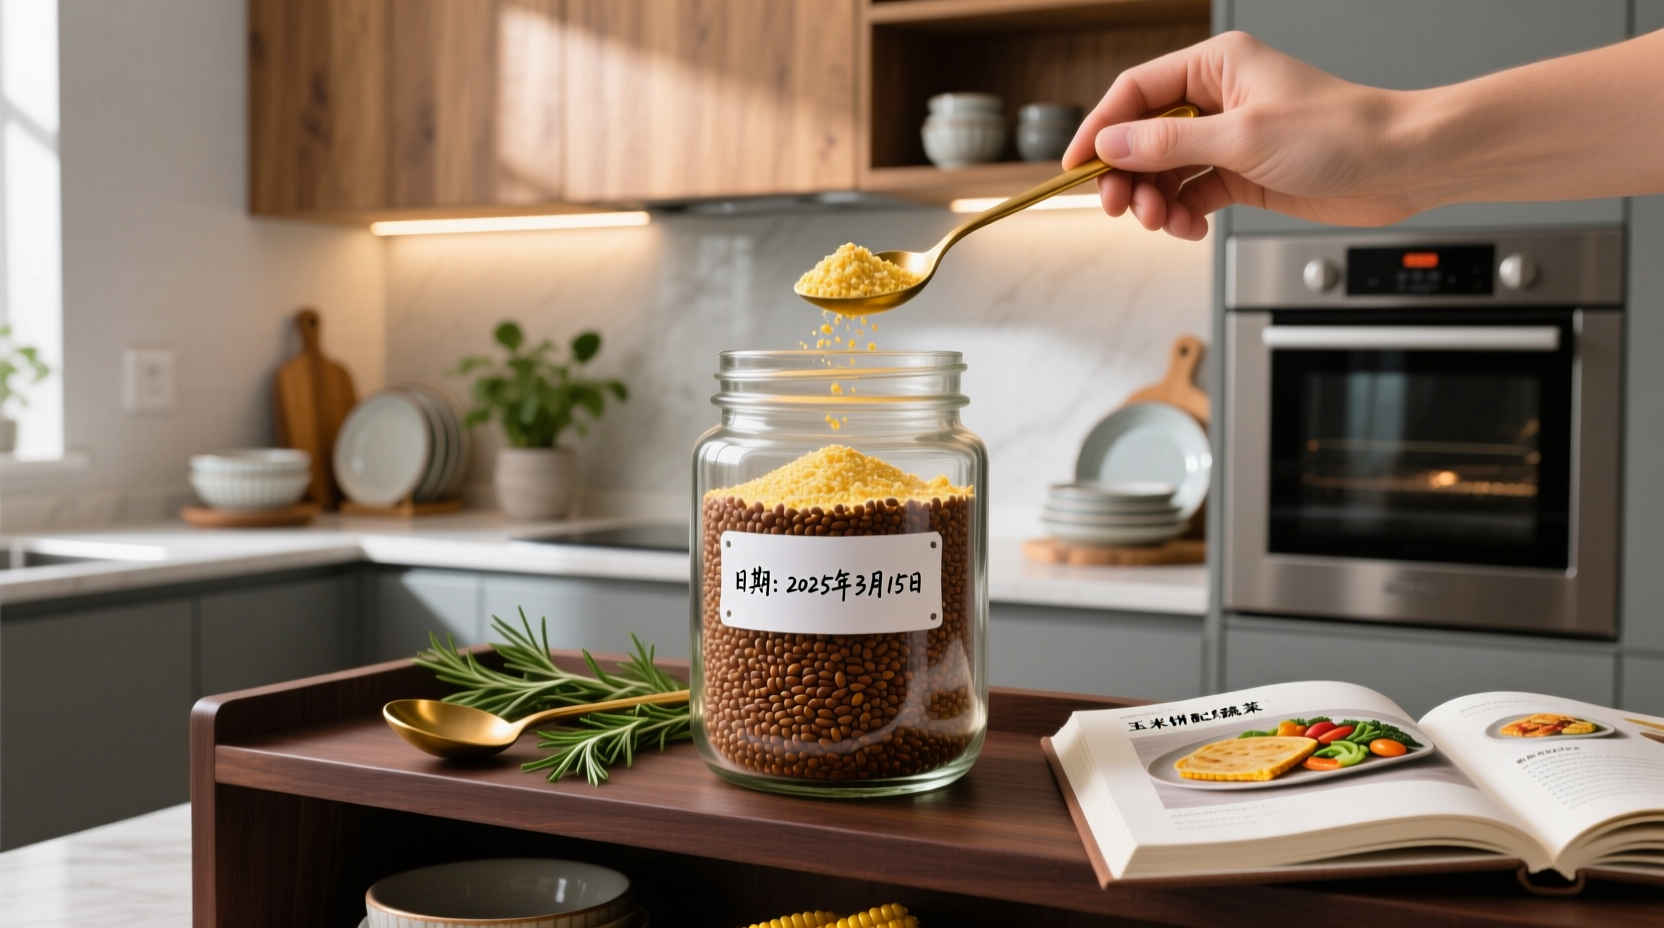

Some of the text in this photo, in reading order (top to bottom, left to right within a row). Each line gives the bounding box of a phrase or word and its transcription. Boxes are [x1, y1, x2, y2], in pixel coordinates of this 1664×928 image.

[736, 566, 922, 602] 日期: 2025年3月15日
